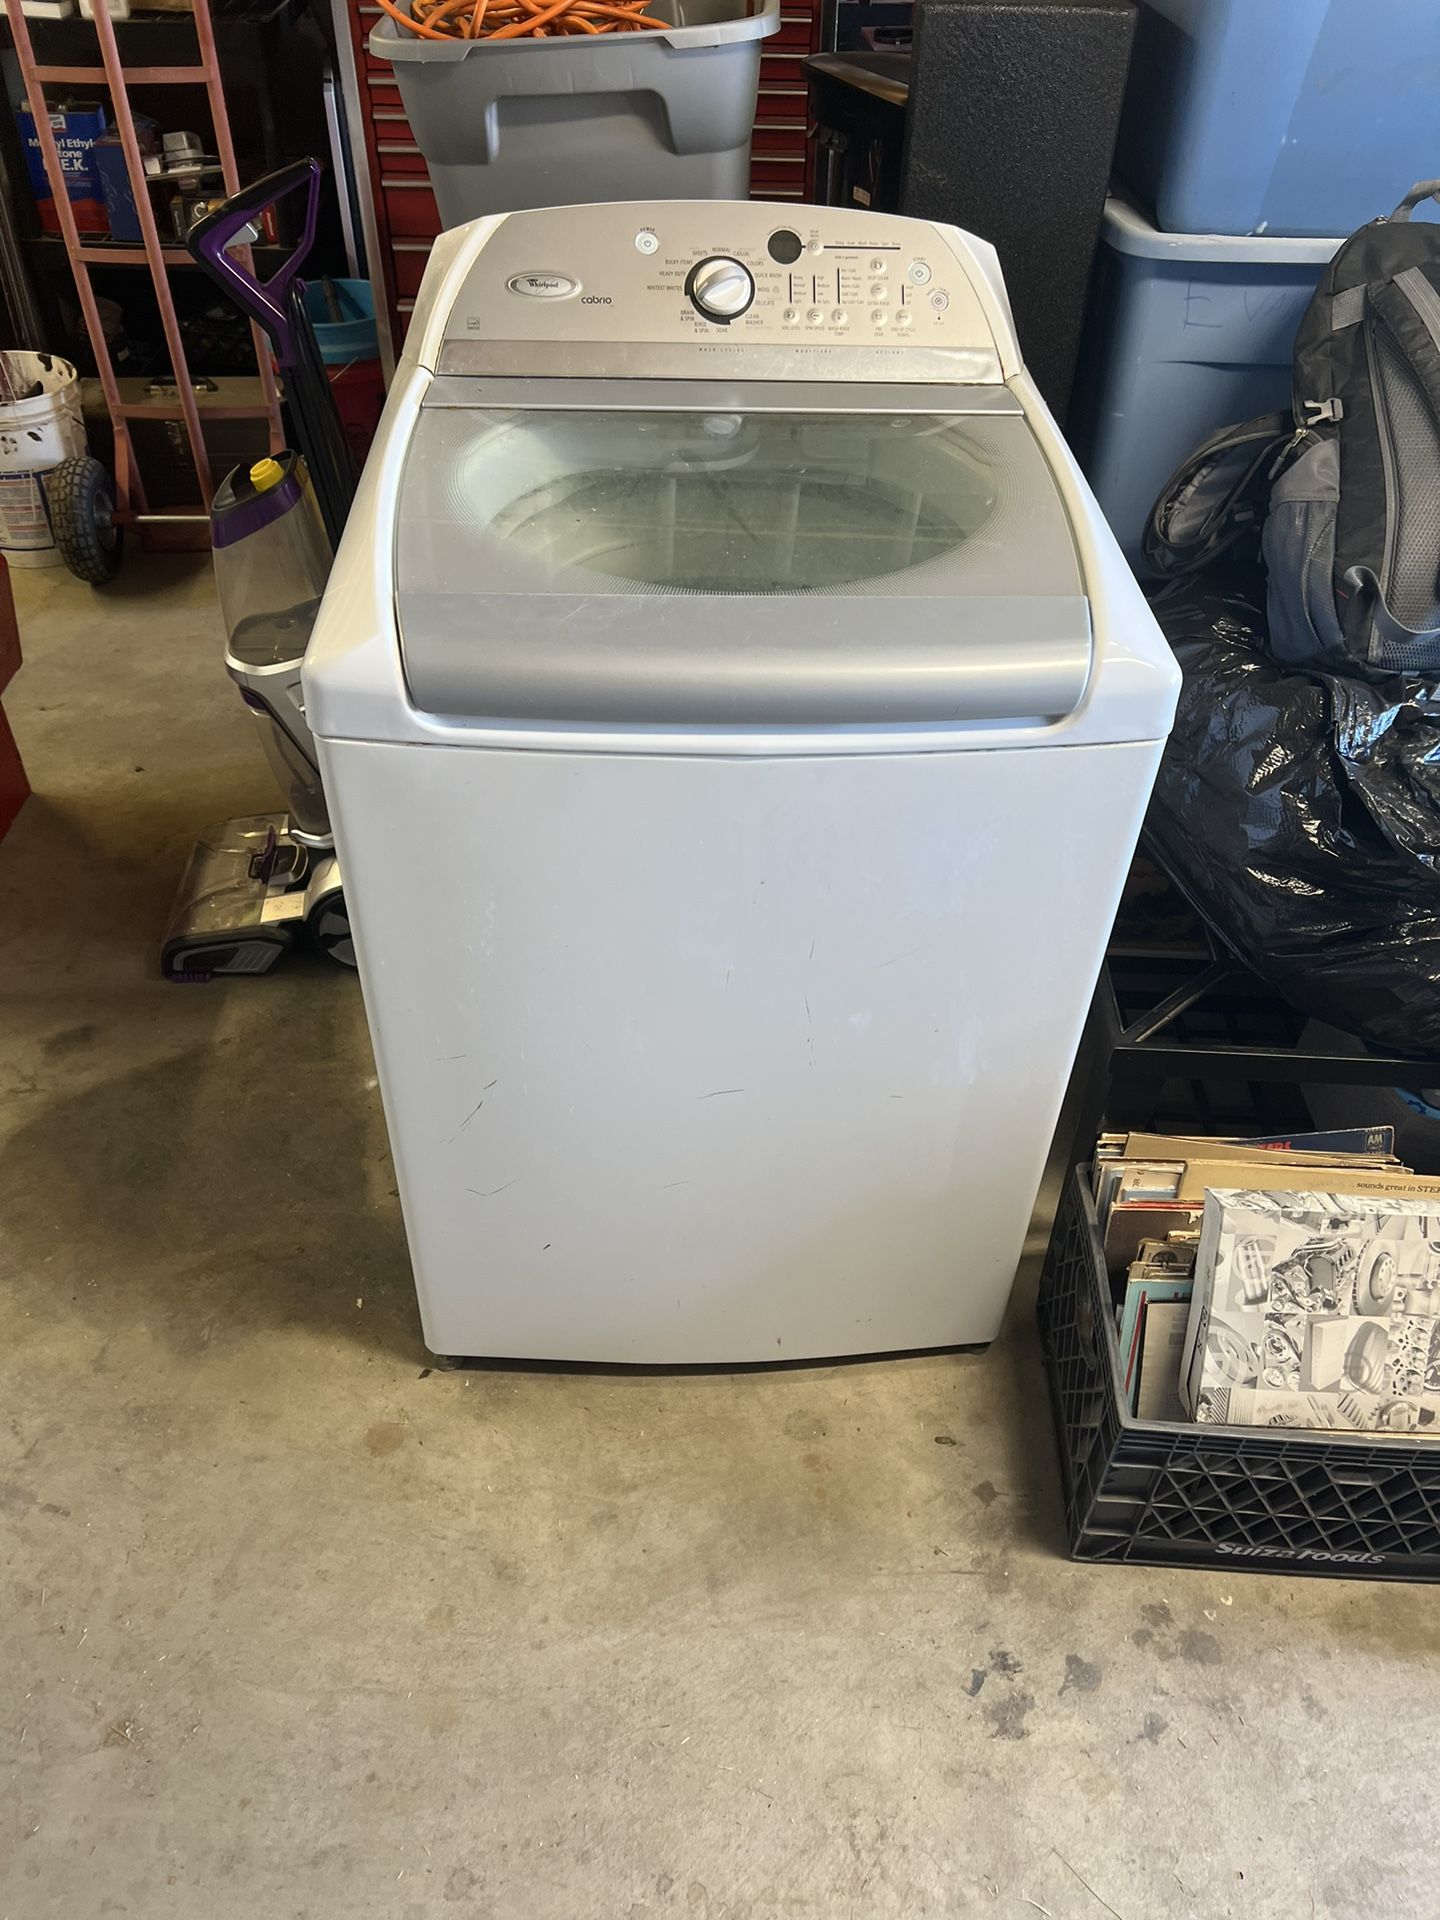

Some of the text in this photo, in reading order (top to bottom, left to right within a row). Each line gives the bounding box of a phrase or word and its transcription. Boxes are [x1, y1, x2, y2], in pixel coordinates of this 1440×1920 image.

[57, 149, 83, 158] tone
[526, 279, 559, 289] Whirlpool
[581, 296, 612, 304] cabrio
[1356, 1182, 1385, 1190] sounds
[1214, 1541, 1296, 1558] Suiza
